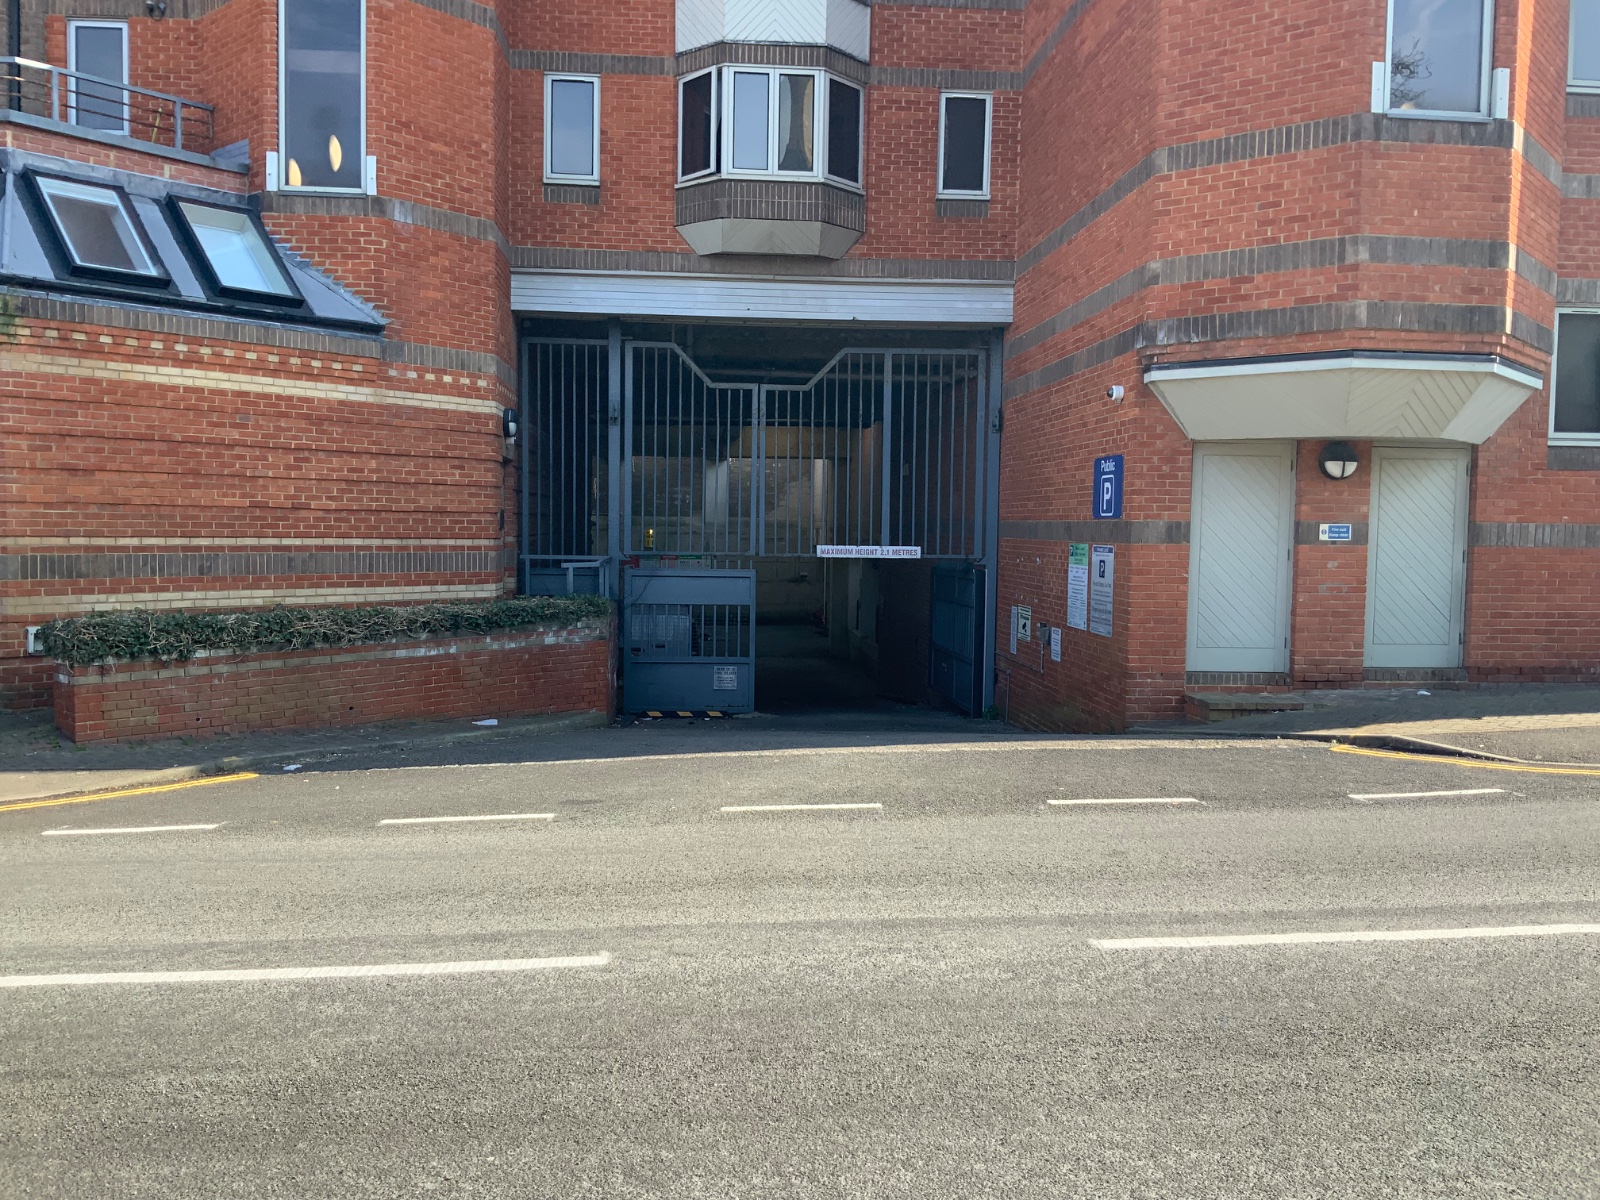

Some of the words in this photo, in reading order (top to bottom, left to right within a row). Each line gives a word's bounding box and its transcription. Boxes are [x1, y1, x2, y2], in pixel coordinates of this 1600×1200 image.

[1101, 459, 1115, 472] Public
[1103, 482, 1111, 510] P
[855, 548, 878, 556] HEIGHT
